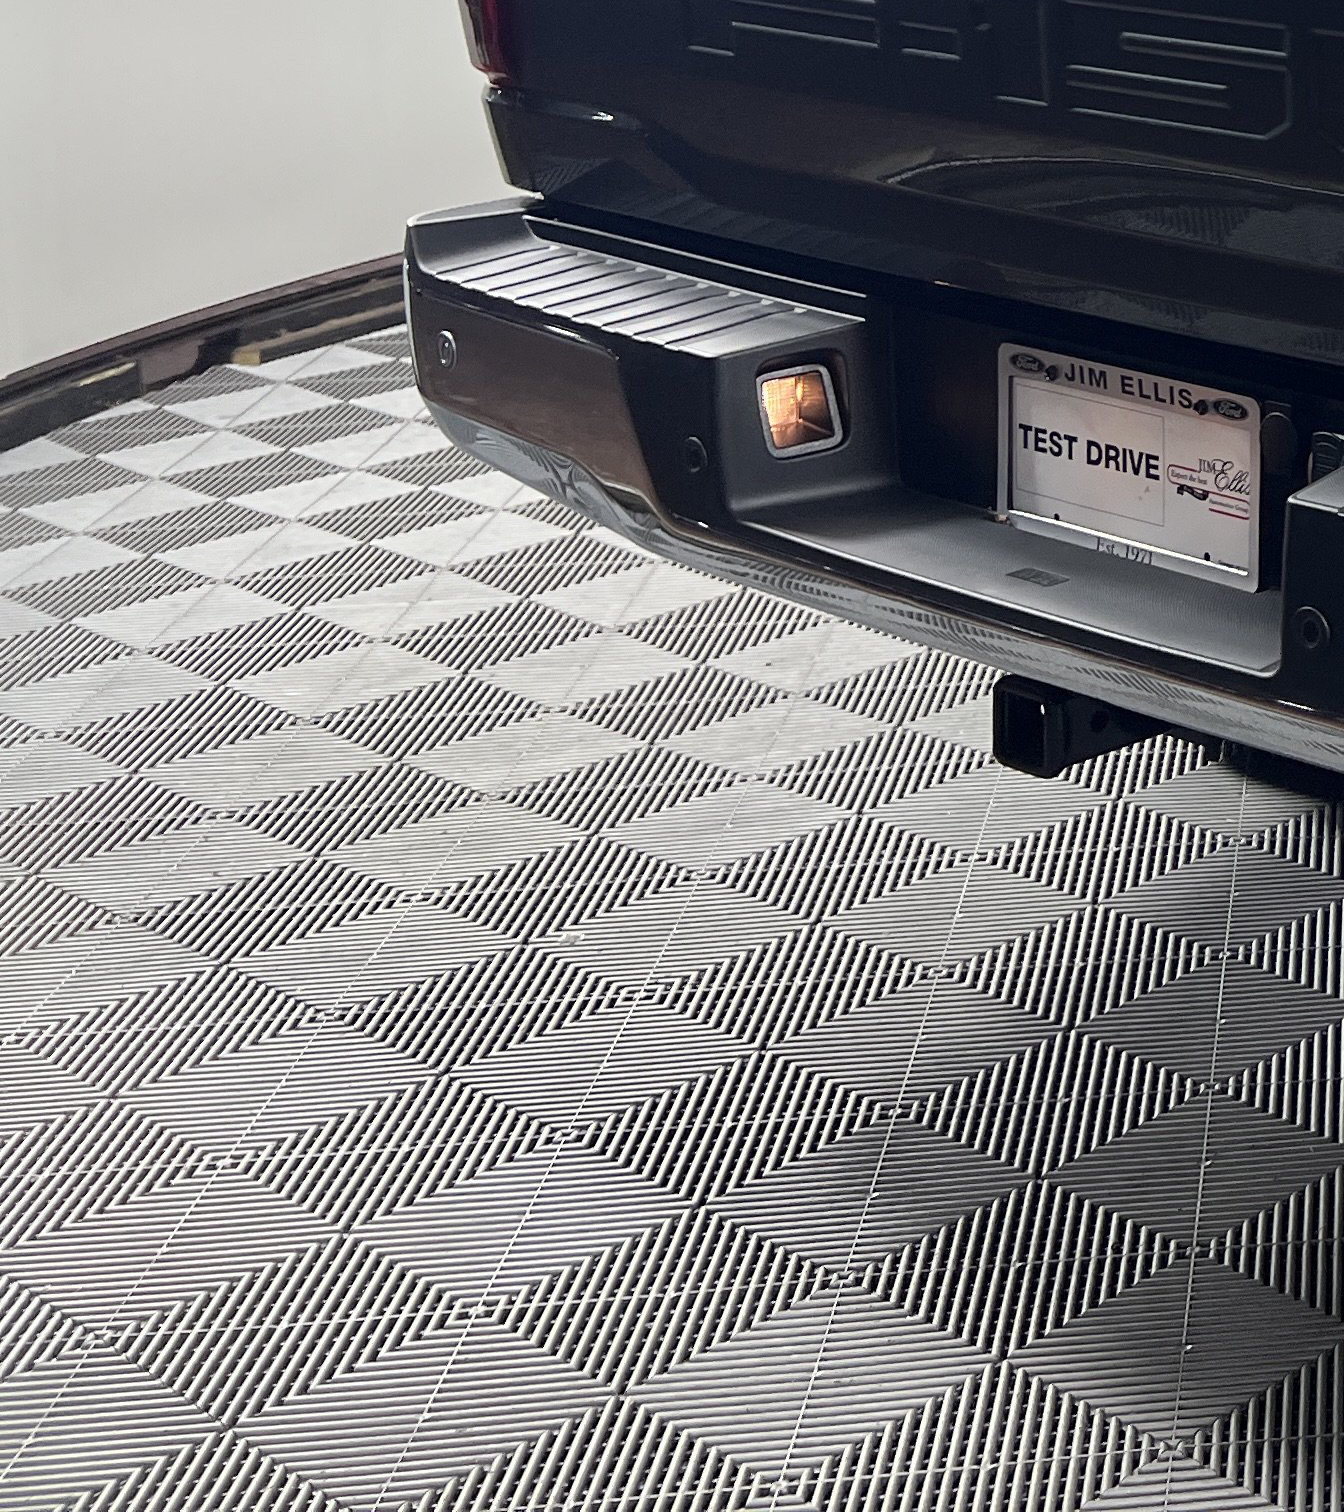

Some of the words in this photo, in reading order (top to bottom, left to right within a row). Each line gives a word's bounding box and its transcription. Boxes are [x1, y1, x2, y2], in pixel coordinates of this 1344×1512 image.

[1065, 363, 1108, 390] JIM
[1119, 374, 1193, 409] ELLIS
[1018, 423, 1078, 460] TEST
[1086, 440, 1160, 480] DRIVE
